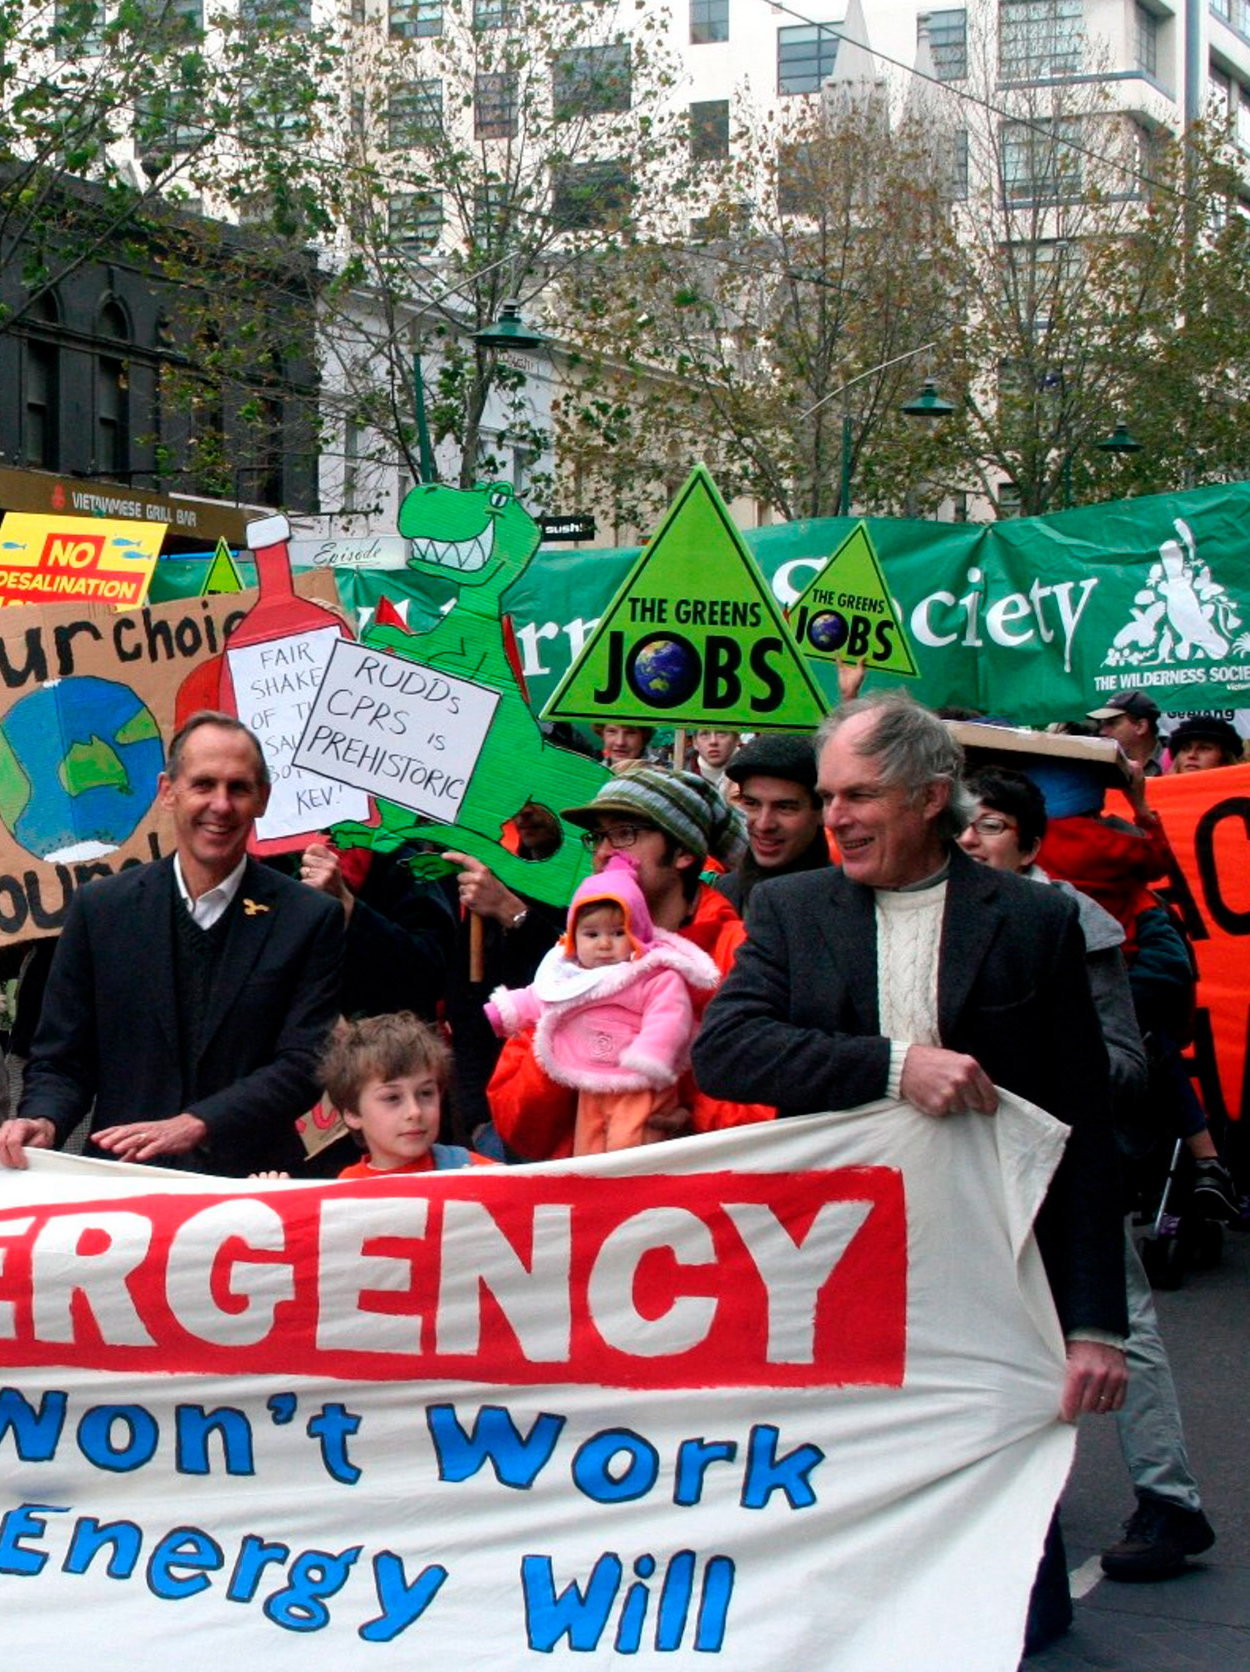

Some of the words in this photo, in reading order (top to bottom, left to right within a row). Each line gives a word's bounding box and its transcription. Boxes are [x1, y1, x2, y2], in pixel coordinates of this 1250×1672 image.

[72, 491, 142, 518] VIETNAMESE
[146, 504, 173, 523] GRILL
[176, 509, 197, 527] BAR
[48, 539, 96, 569] NO
[628, 597, 669, 625] THE
[674, 598, 762, 628] GREENS
[772, 556, 1098, 673] Sciety
[813, 588, 835, 606] THE
[837, 593, 885, 614] GREENS
[795, 605, 894, 662] JOBS
[260, 642, 315, 670] FAIR
[593, 630, 788, 713] JOBS
[250, 667, 323, 701] SHAKE
[1094, 675, 1117, 691] THE
[1120, 668, 1207, 688] WILDERNESS
[251, 707, 276, 730] OF
[326, 689, 411, 735] CPRS
[306, 725, 465, 800] PREHISTORIC
[296, 786, 344, 815] KEV!
[427, 1403, 825, 1509] Work
[521, 1550, 736, 1655] Will
